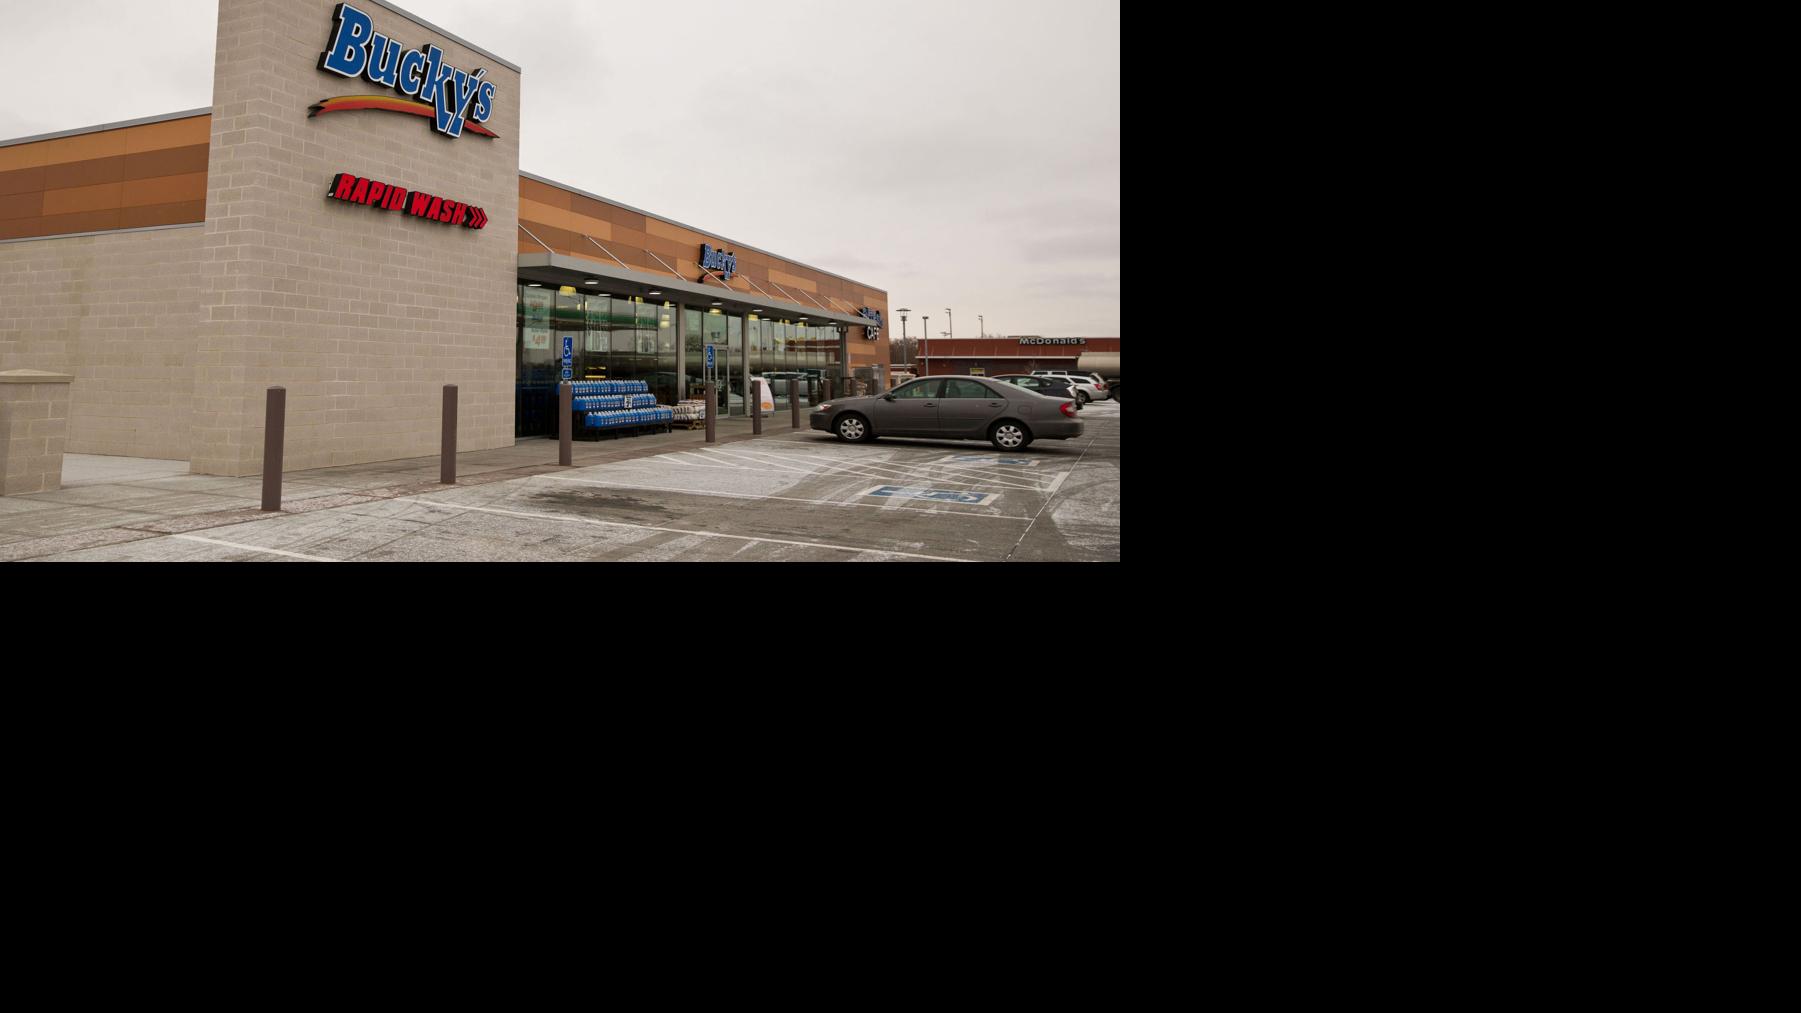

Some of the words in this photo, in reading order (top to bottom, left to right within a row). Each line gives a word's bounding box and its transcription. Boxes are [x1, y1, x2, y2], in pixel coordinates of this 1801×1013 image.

[321, 3, 497, 138] Bucky's
[333, 173, 408, 212] RAPID
[408, 191, 467, 226] WASH
[702, 243, 737, 281] Bucky's
[1019, 337, 1086, 345] McDonald's
